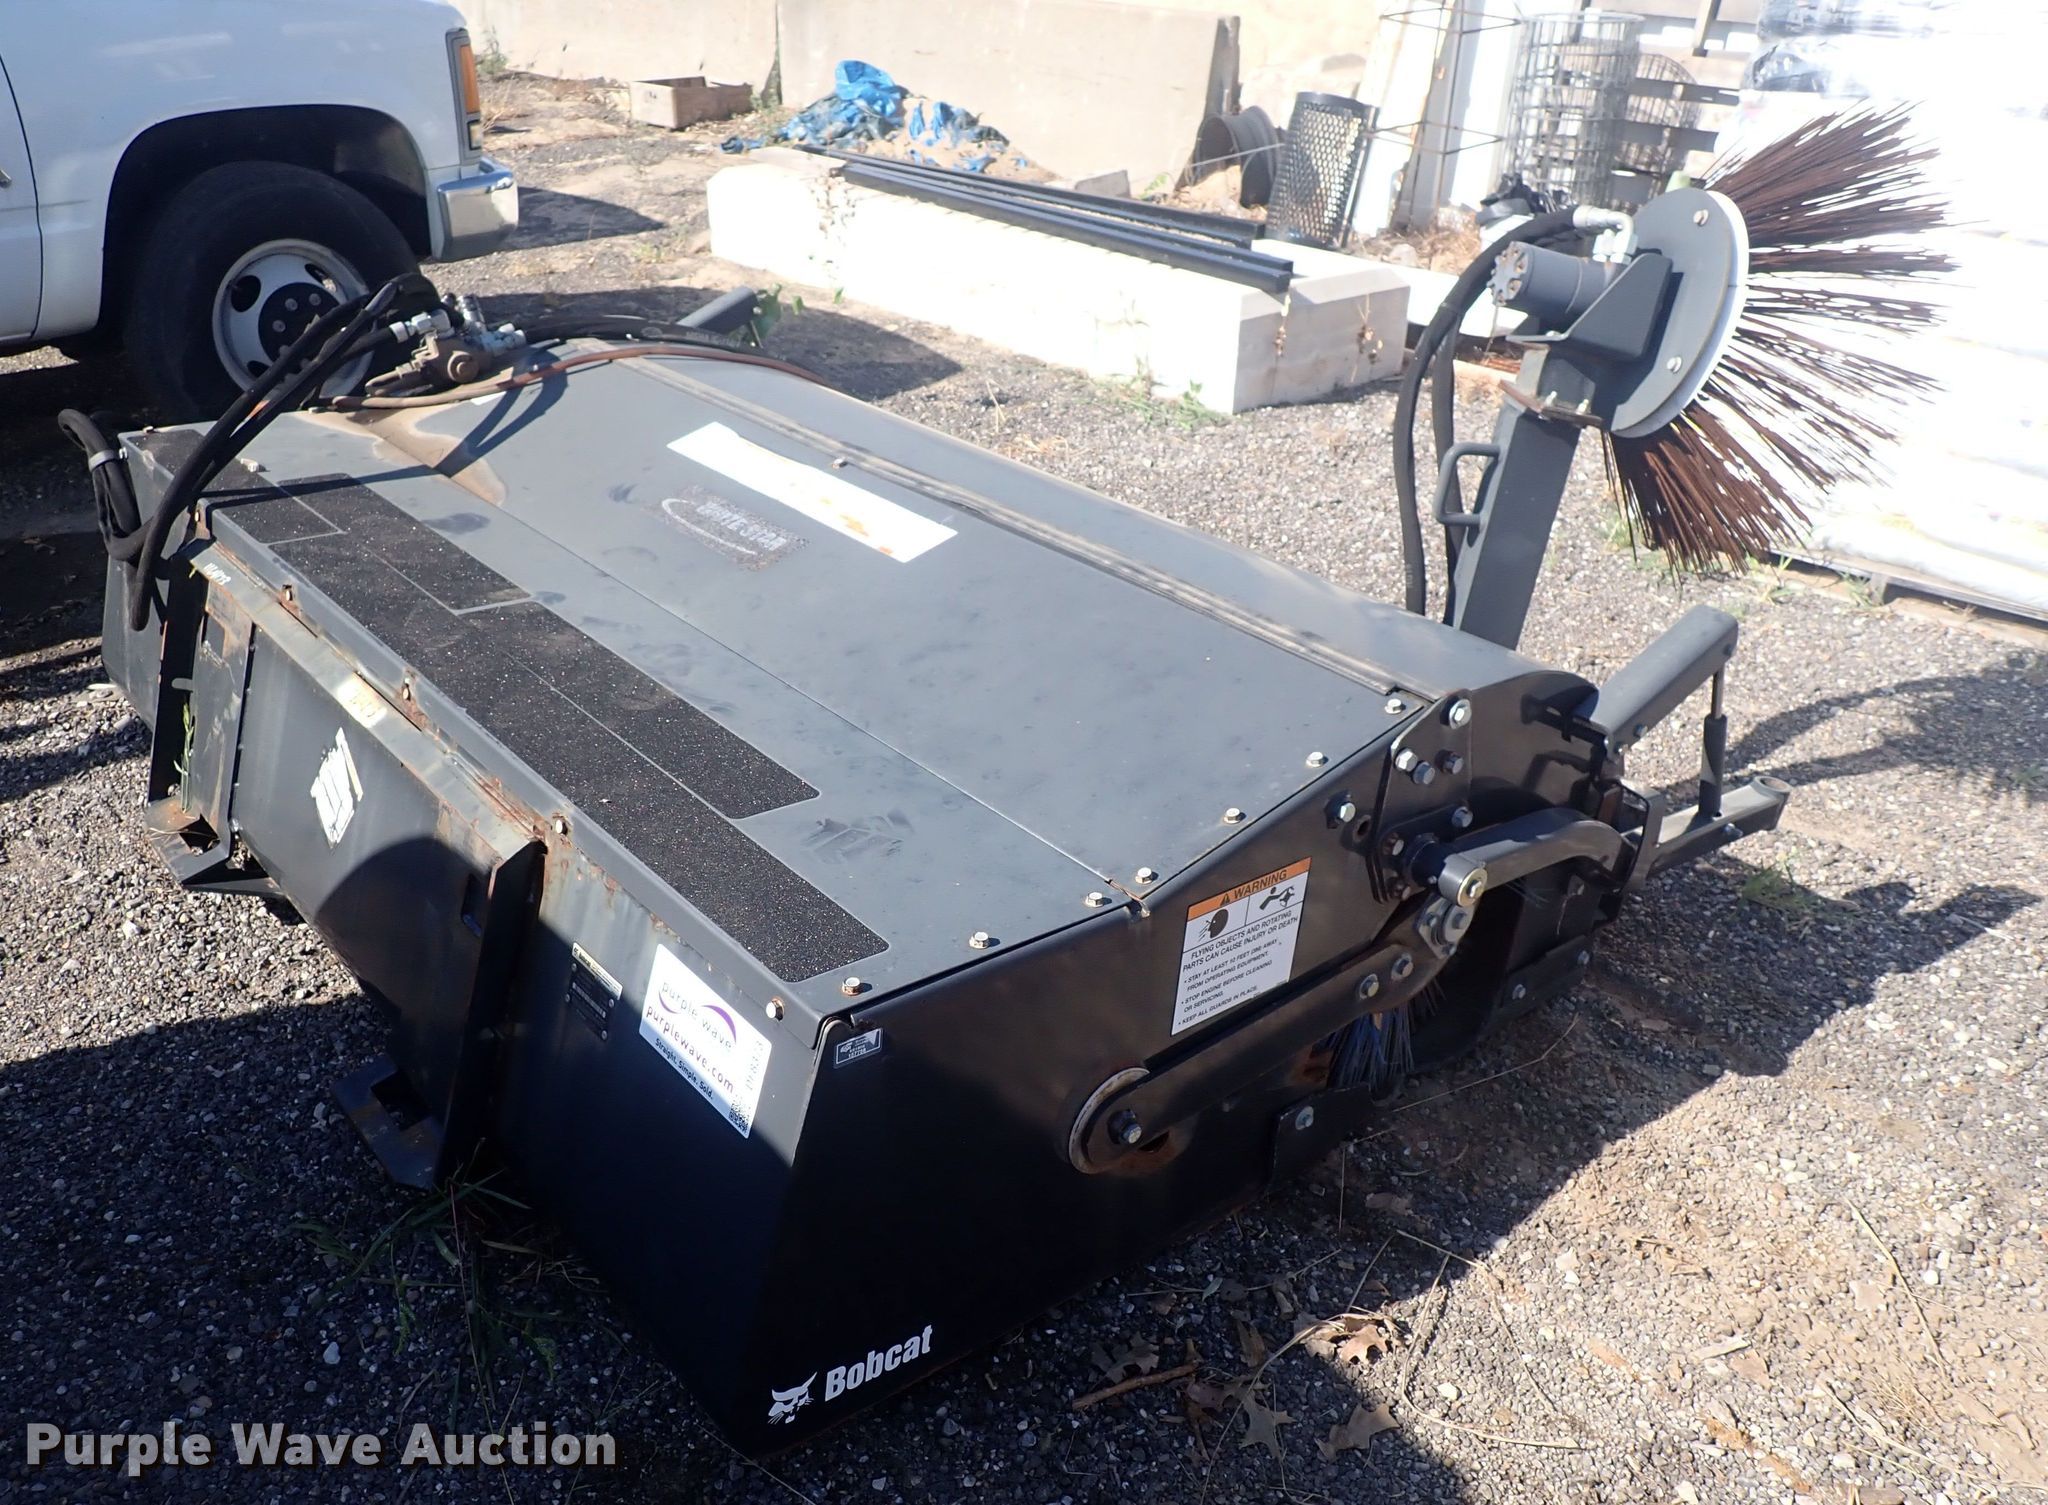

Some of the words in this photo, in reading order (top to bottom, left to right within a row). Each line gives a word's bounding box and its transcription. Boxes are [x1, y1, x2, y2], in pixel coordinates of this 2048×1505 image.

[1234, 869, 1287, 899] WARNING
[1183, 957, 1204, 973] PARTS
[1205, 951, 1220, 962] CAN
[1221, 941, 1242, 955] CAUSE
[1243, 931, 1266, 946] INJURY
[1267, 925, 1277, 935] OR
[1278, 916, 1298, 930] DEATH
[1191, 944, 1214, 960] FLYING
[1215, 931, 1245, 948] OBJECTS
[1246, 923, 1260, 935] AND
[1261, 910, 1292, 928] ROTATING
[1185, 992, 1201, 1004] STOP
[1201, 982, 1222, 996] ENGINE
[1223, 973, 1245, 986] BEFORE
[1245, 959, 1273, 976] CLEANING
[1187, 980, 1204, 991] FROM
[1204, 966, 1236, 984] OPERATING
[1188, 972, 1202, 983] STAY
[1202, 968, 1210, 976] AT
[1210, 960, 1229, 973] LEAST
[1236, 951, 1250, 961] FEET
[661, 981, 698, 1022] purple
[702, 1017, 733, 1051] wave
[1182, 1013, 1197, 1024] KEEP
[1198, 1007, 1209, 1017] ALL
[1184, 1004, 1193, 1013] OR
[646, 1005, 735, 1094] purplewave.com
[655, 1033, 677, 1065] Straight.
[678, 1060, 699, 1088] Simple.
[699, 1081, 713, 1100] Sold.
[824, 1324, 933, 1402] Bobcat
